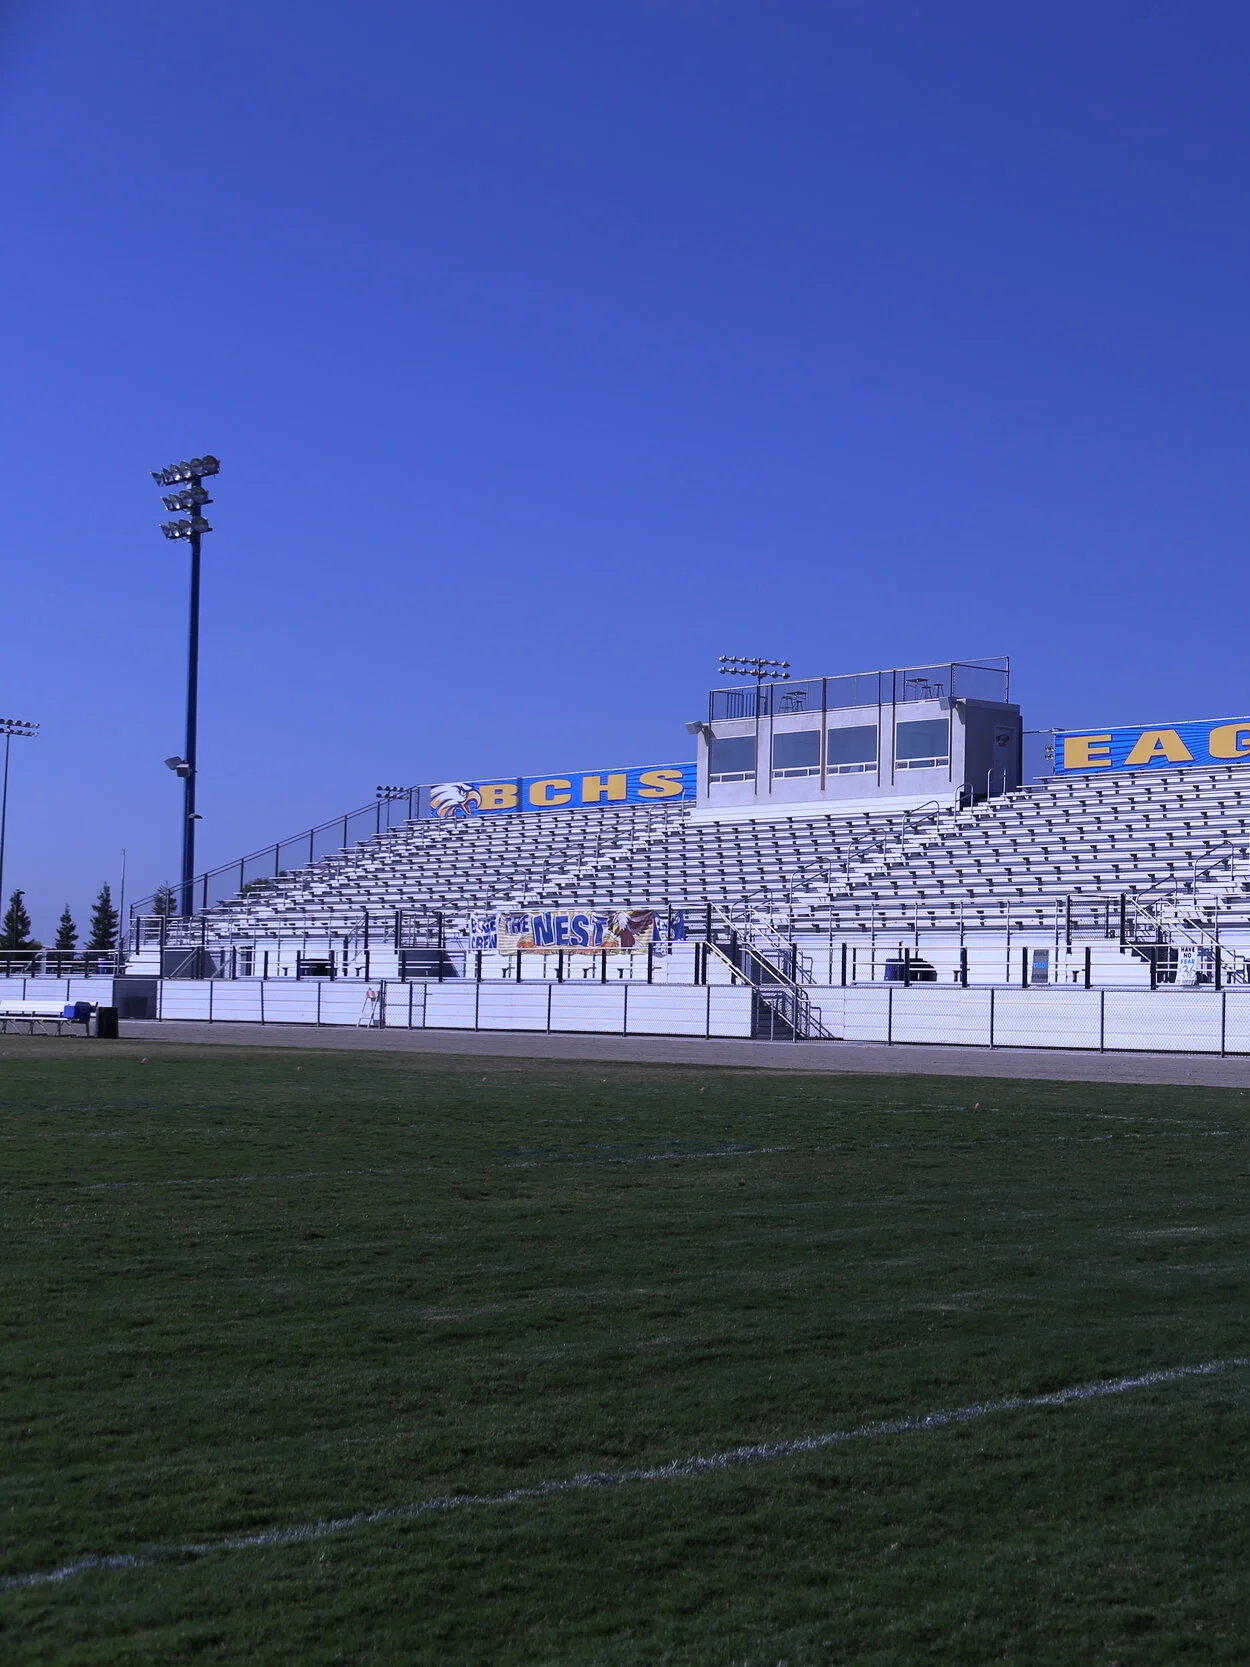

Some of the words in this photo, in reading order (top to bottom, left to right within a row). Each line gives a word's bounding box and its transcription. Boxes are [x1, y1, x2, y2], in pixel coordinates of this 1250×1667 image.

[478, 769, 685, 811] BCHS
[504, 914, 529, 933] THE
[533, 912, 608, 946] NEST
